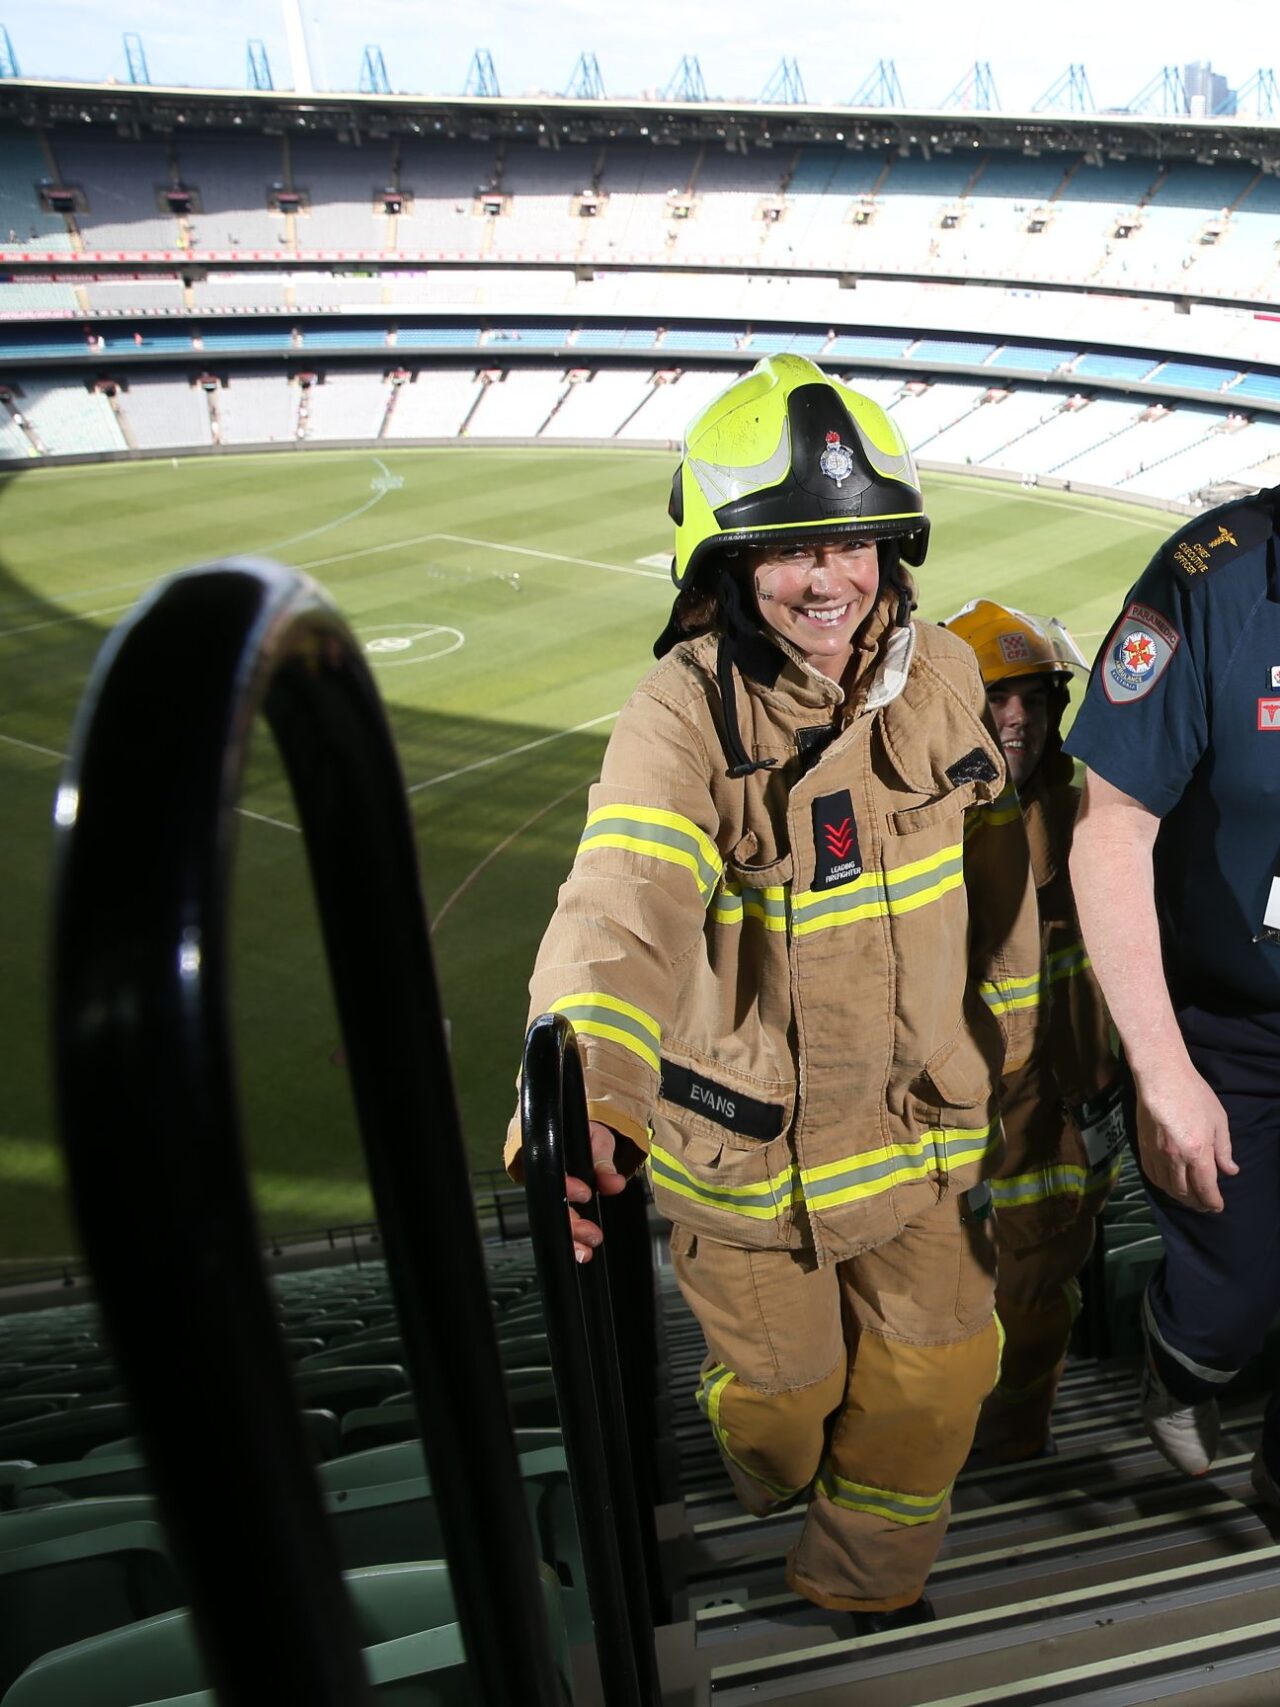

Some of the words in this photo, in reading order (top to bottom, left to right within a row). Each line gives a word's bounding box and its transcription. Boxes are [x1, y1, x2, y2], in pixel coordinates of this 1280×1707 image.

[1179, 542, 1209, 573] EXECUTIVE
[1193, 543, 1211, 558] CHIEF
[1173, 551, 1197, 576] OFFICER
[1132, 606, 1177, 644] PARAMEDIC
[1115, 660, 1142, 684] AMBULANCE
[825, 866, 862, 883] FIREFIGHTER
[830, 860, 856, 874] LEADING
[690, 1083, 736, 1118] EVANS
